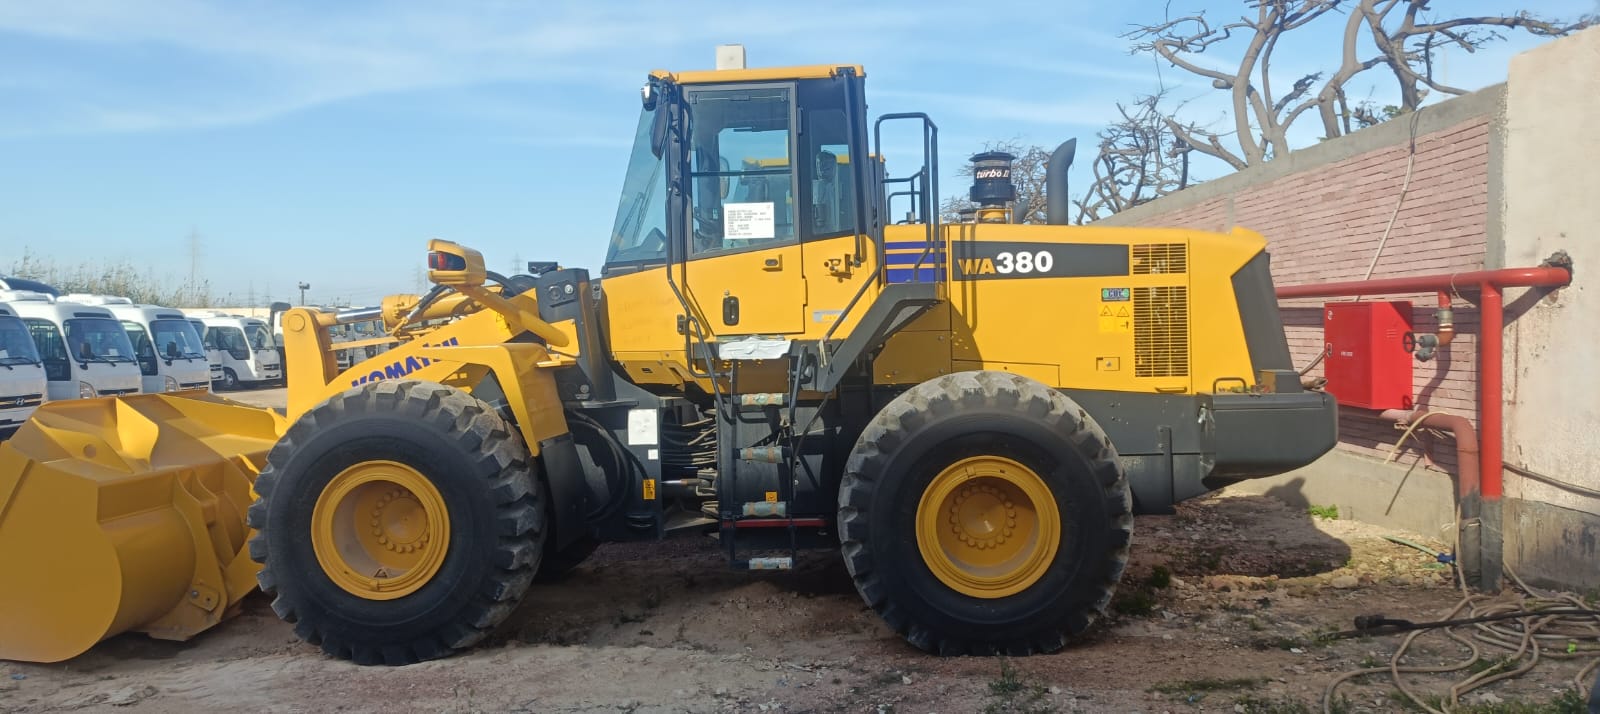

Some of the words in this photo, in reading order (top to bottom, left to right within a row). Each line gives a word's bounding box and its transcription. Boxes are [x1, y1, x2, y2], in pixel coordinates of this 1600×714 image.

[976, 169, 1002, 179] turbo
[958, 251, 1053, 274] WA380
[352, 337, 457, 387] KOMATU
